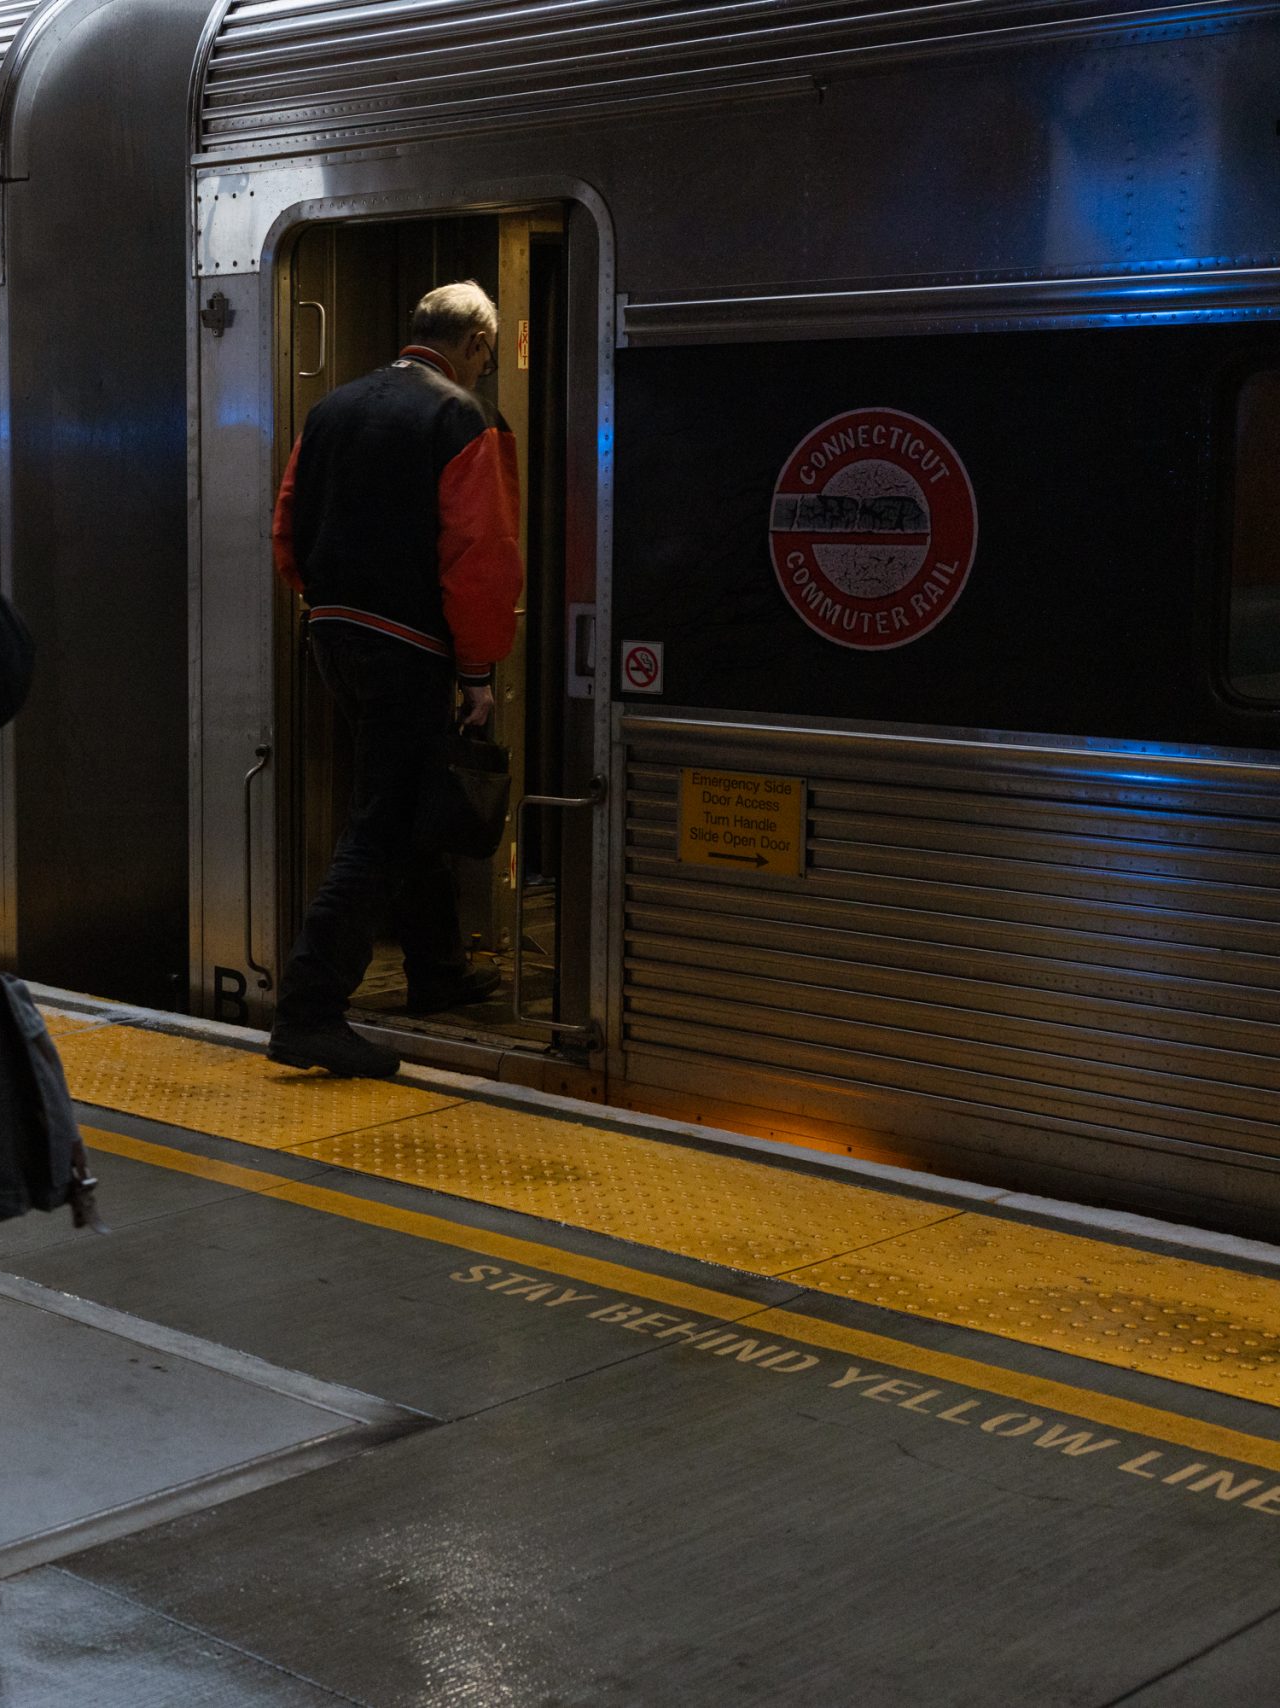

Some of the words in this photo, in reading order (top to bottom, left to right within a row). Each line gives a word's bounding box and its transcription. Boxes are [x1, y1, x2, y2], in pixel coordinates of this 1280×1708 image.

[799, 424, 951, 485] CONNECTICUT
[786, 551, 910, 634] COMMUTER
[910, 559, 960, 616] RAIL
[692, 772, 760, 793] Emergency
[764, 780, 792, 795] Side
[702, 791, 731, 806] Door
[735, 795, 780, 812] Access
[690, 827, 719, 842] Slide
[723, 831, 756, 849] Open
[760, 835, 791, 851] Door
[704, 811, 729, 826] Turn
[734, 815, 777, 832] Handle
[214, 966, 249, 1026] B
[448, 1265, 599, 1308] STAY
[585, 1302, 821, 1373] BEHIND
[827, 1366, 1121, 1457] YELLOW
